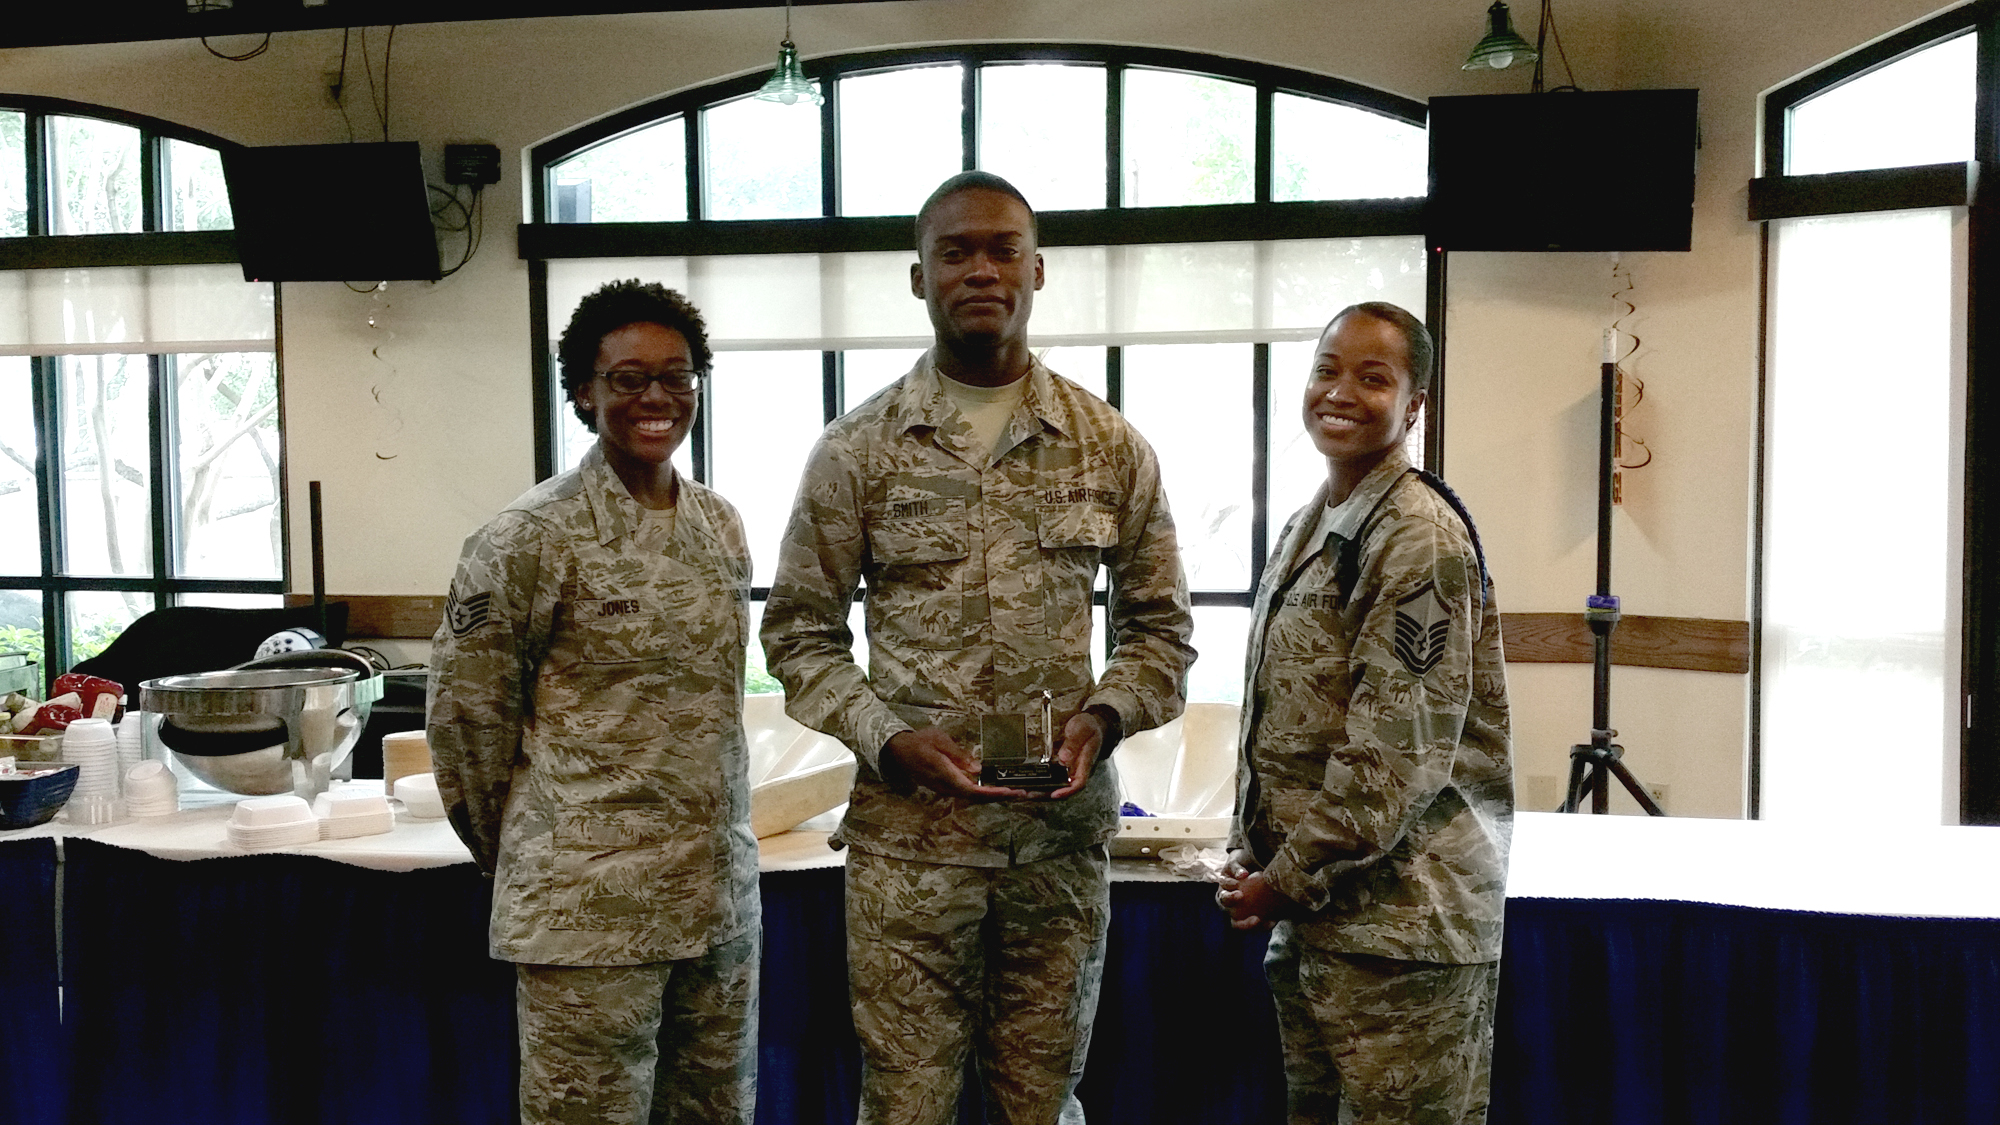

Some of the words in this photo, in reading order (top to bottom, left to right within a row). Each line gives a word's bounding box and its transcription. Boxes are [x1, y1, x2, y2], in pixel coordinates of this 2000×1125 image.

[1067, 489, 1088, 504] AIR
[893, 500, 928, 518] SMITH
[597, 599, 640, 616] JONES
[1301, 593, 1318, 609] AIR
